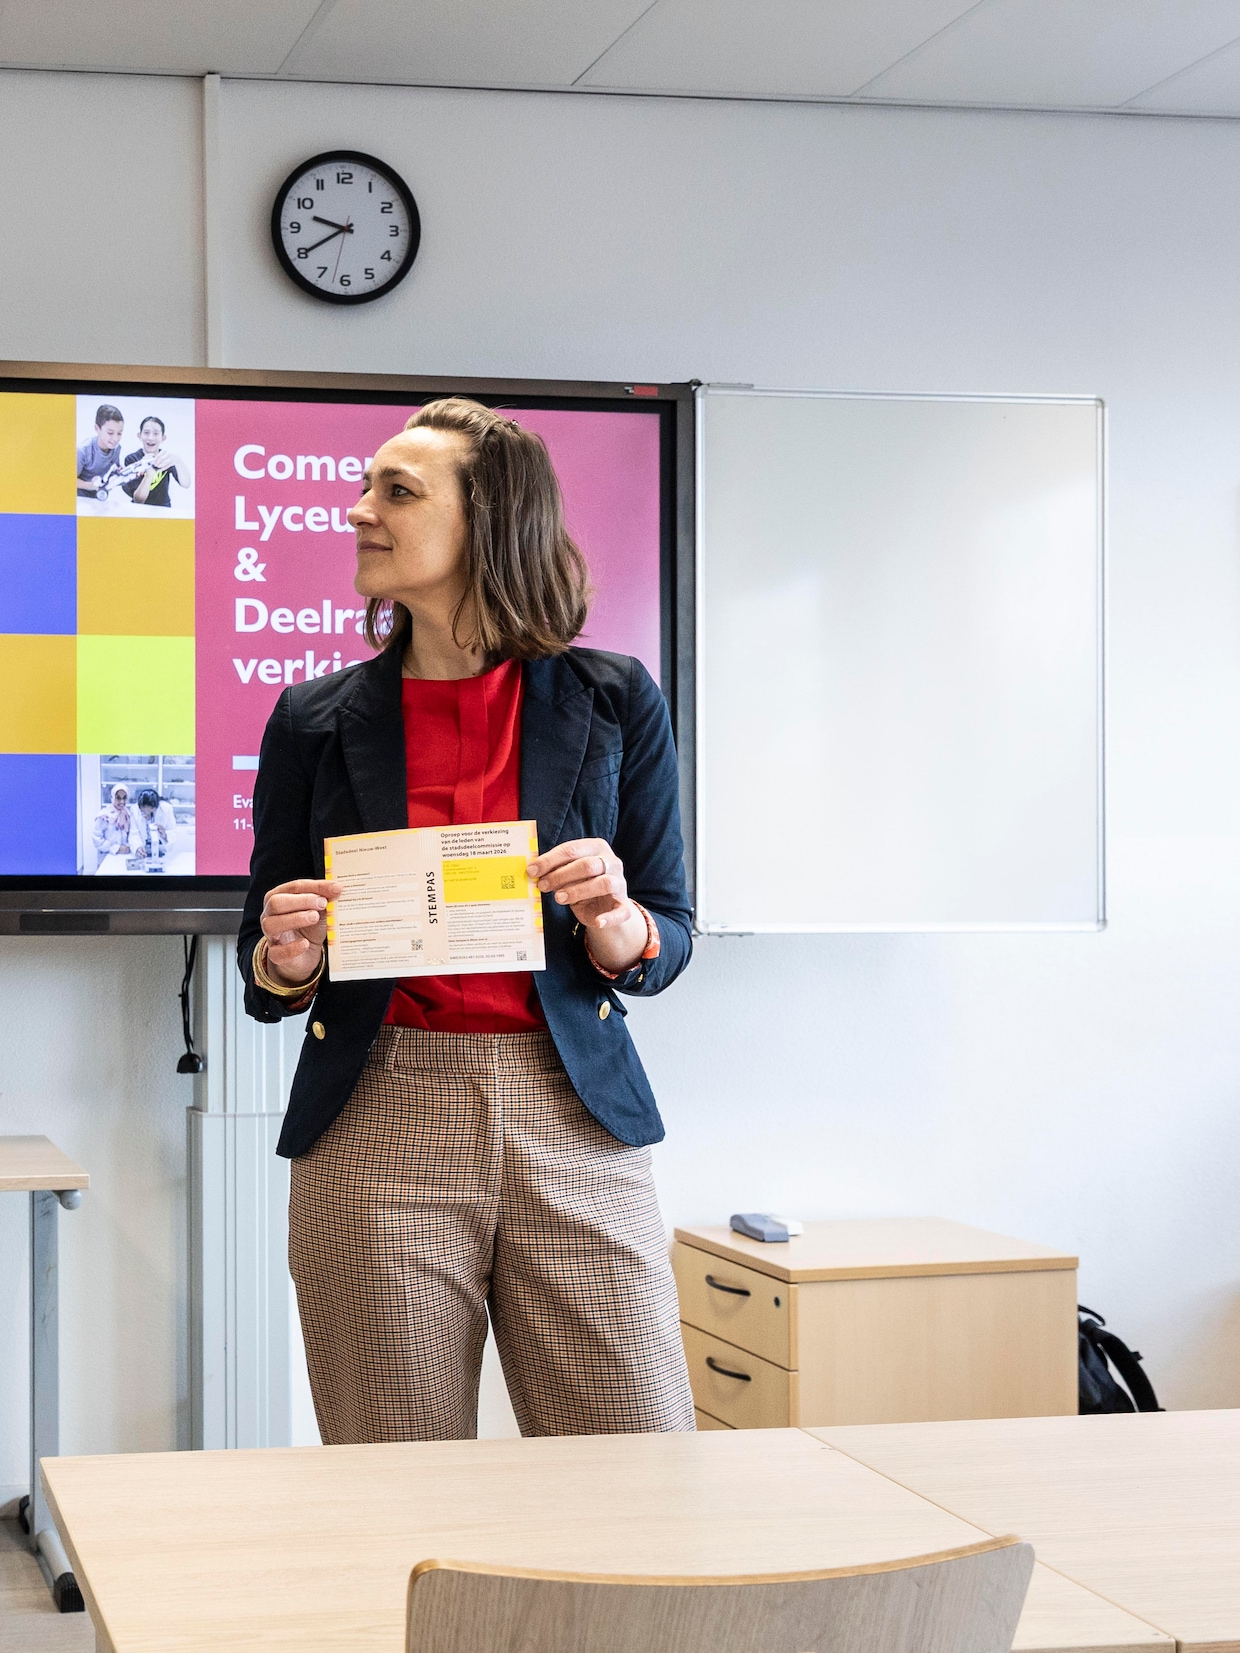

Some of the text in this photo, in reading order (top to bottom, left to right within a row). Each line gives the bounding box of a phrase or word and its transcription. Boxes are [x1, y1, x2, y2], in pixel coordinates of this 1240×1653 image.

[336, 172, 354, 184] 12
[316, 179, 325, 191] 11
[368, 181, 373, 193] 1
[297, 197, 314, 210] 10
[380, 201, 393, 214] 2
[289, 221, 301, 234] 9
[389, 225, 399, 237] 3
[297, 247, 309, 259] 8
[380, 250, 393, 262] 4
[316, 266, 328, 279] 7
[364, 268, 375, 280] 5
[339, 274, 351, 287] 6
[233, 443, 373, 482] Come
[233, 546, 267, 582] &
[232, 650, 363, 684] verki
[233, 818, 254, 830] 11-
[425, 871, 438, 924] STEMPAS
